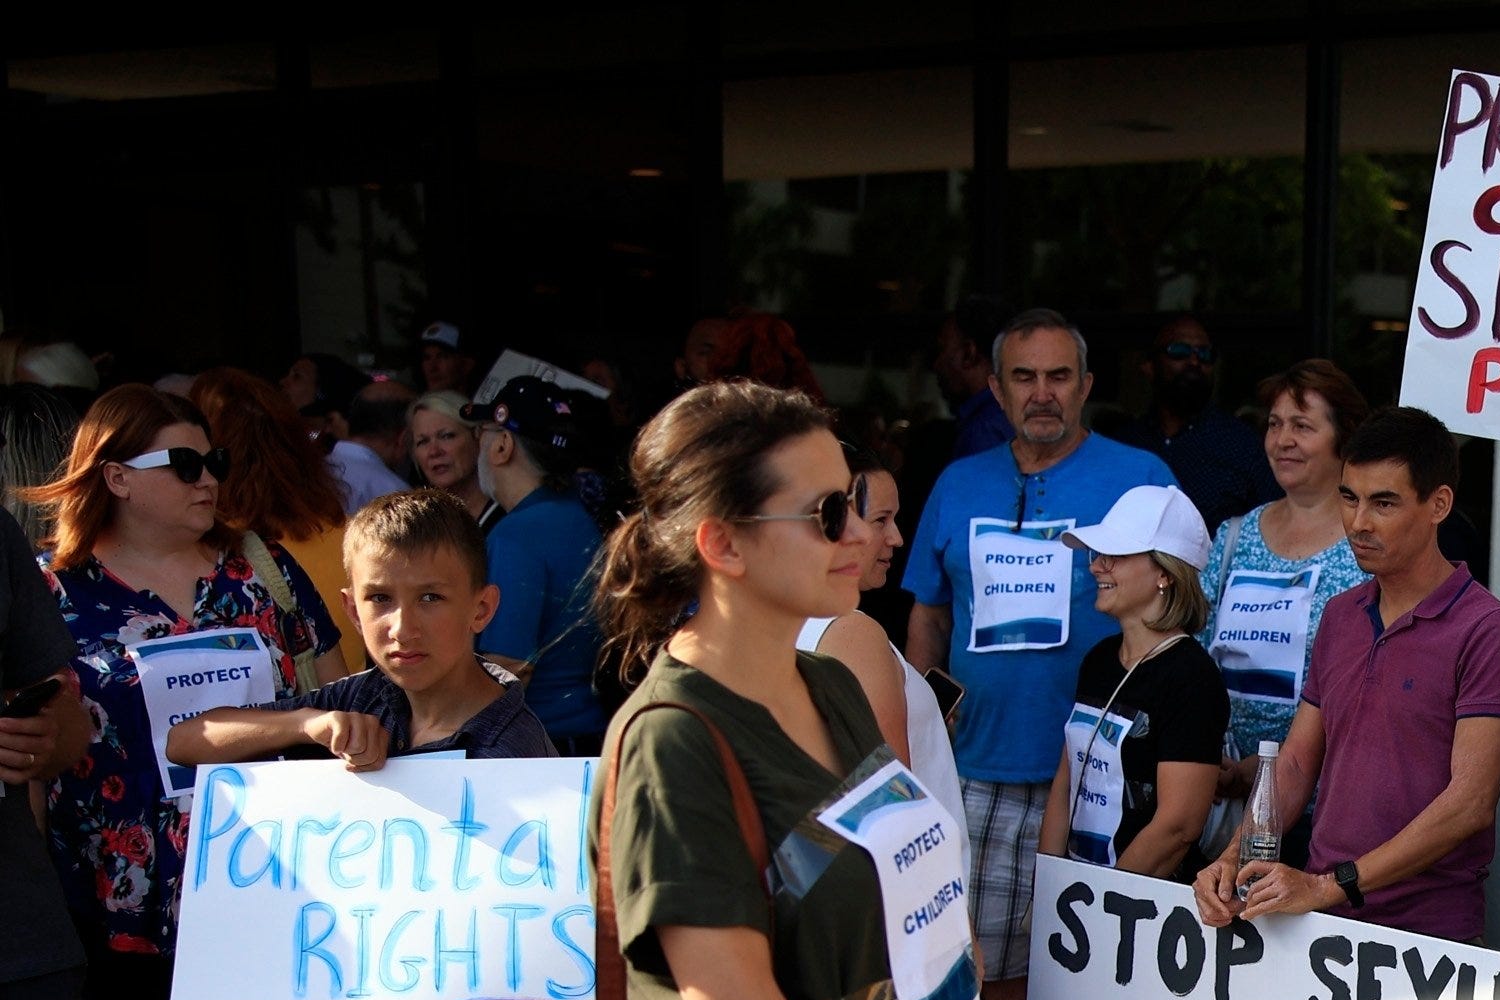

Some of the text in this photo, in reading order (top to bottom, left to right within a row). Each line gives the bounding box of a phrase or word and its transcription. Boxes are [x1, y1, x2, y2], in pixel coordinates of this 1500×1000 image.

[985, 553, 1055, 566] PROTECT
[984, 582, 1056, 597] CHILDREN
[1231, 600, 1293, 613] PROTECT
[1219, 630, 1291, 644] CHILDREN
[166, 666, 252, 690] PROTECT
[1077, 751, 1109, 773] SORT
[1079, 787, 1107, 807] ENTS
[194, 760, 592, 894] Parental
[893, 822, 946, 874] PROTECT
[904, 877, 964, 935] CHILDREN
[293, 900, 596, 999] RIGHTS
